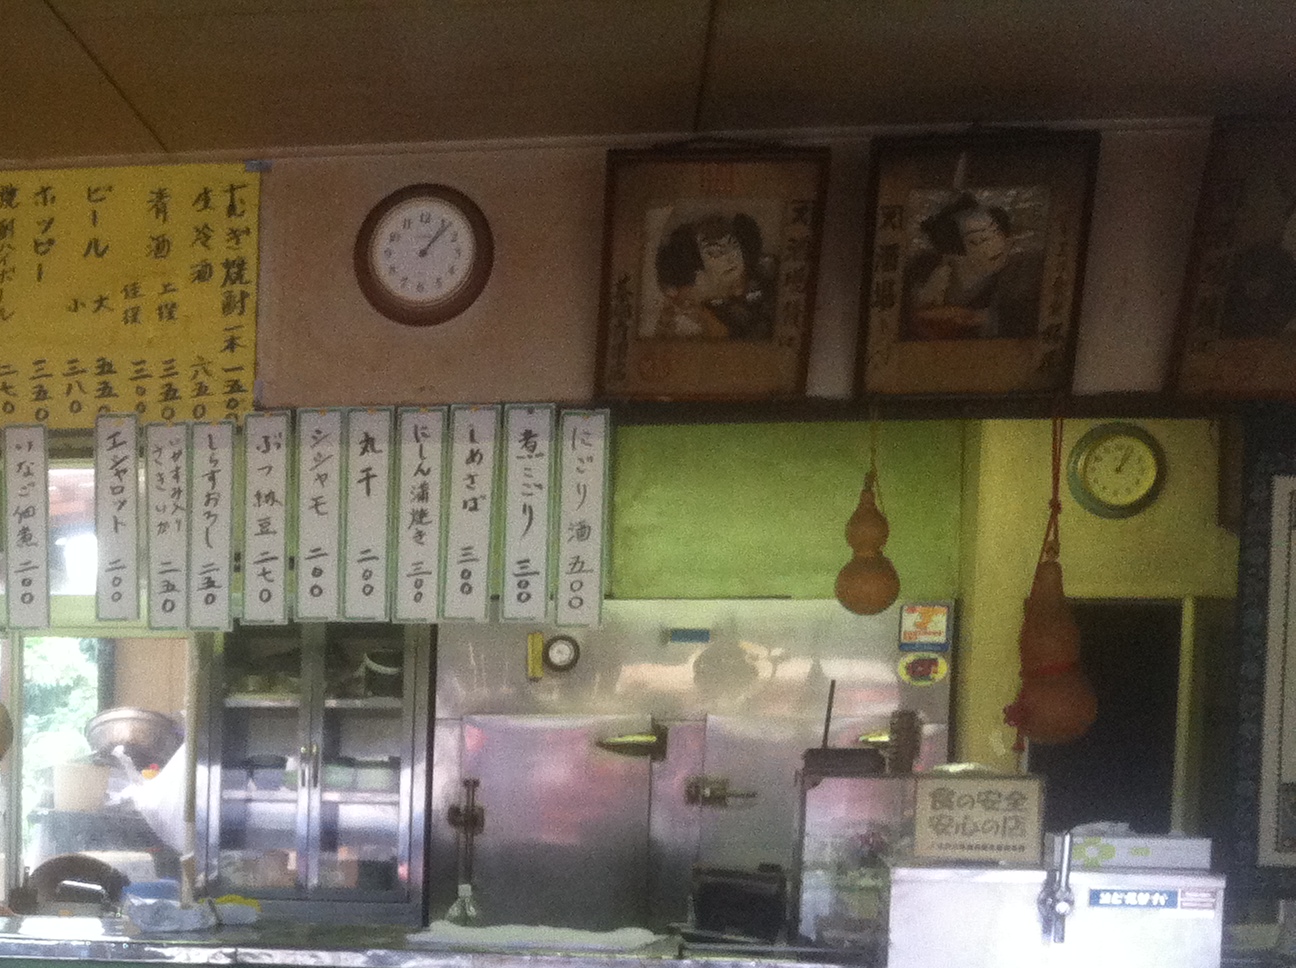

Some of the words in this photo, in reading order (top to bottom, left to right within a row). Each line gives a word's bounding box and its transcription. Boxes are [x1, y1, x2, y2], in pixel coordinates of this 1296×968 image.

[33, 185, 57, 283] ホッピー
[83, 184, 113, 258] ビール
[146, 187, 172, 260] 清酒
[92, 294, 114, 314] 大
[202, 434, 222, 549] しらすおろし
[254, 432, 283, 536] ぶつ納豆
[309, 428, 334, 516] シシャモ
[357, 431, 383, 497] 丸干
[462, 426, 486, 513] しめさば
[515, 429, 545, 540] 煮こごり
[567, 427, 593, 543] にごり酒
[928, 786, 1028, 813] 食の安全
[928, 813, 1027, 838] 安心の店
